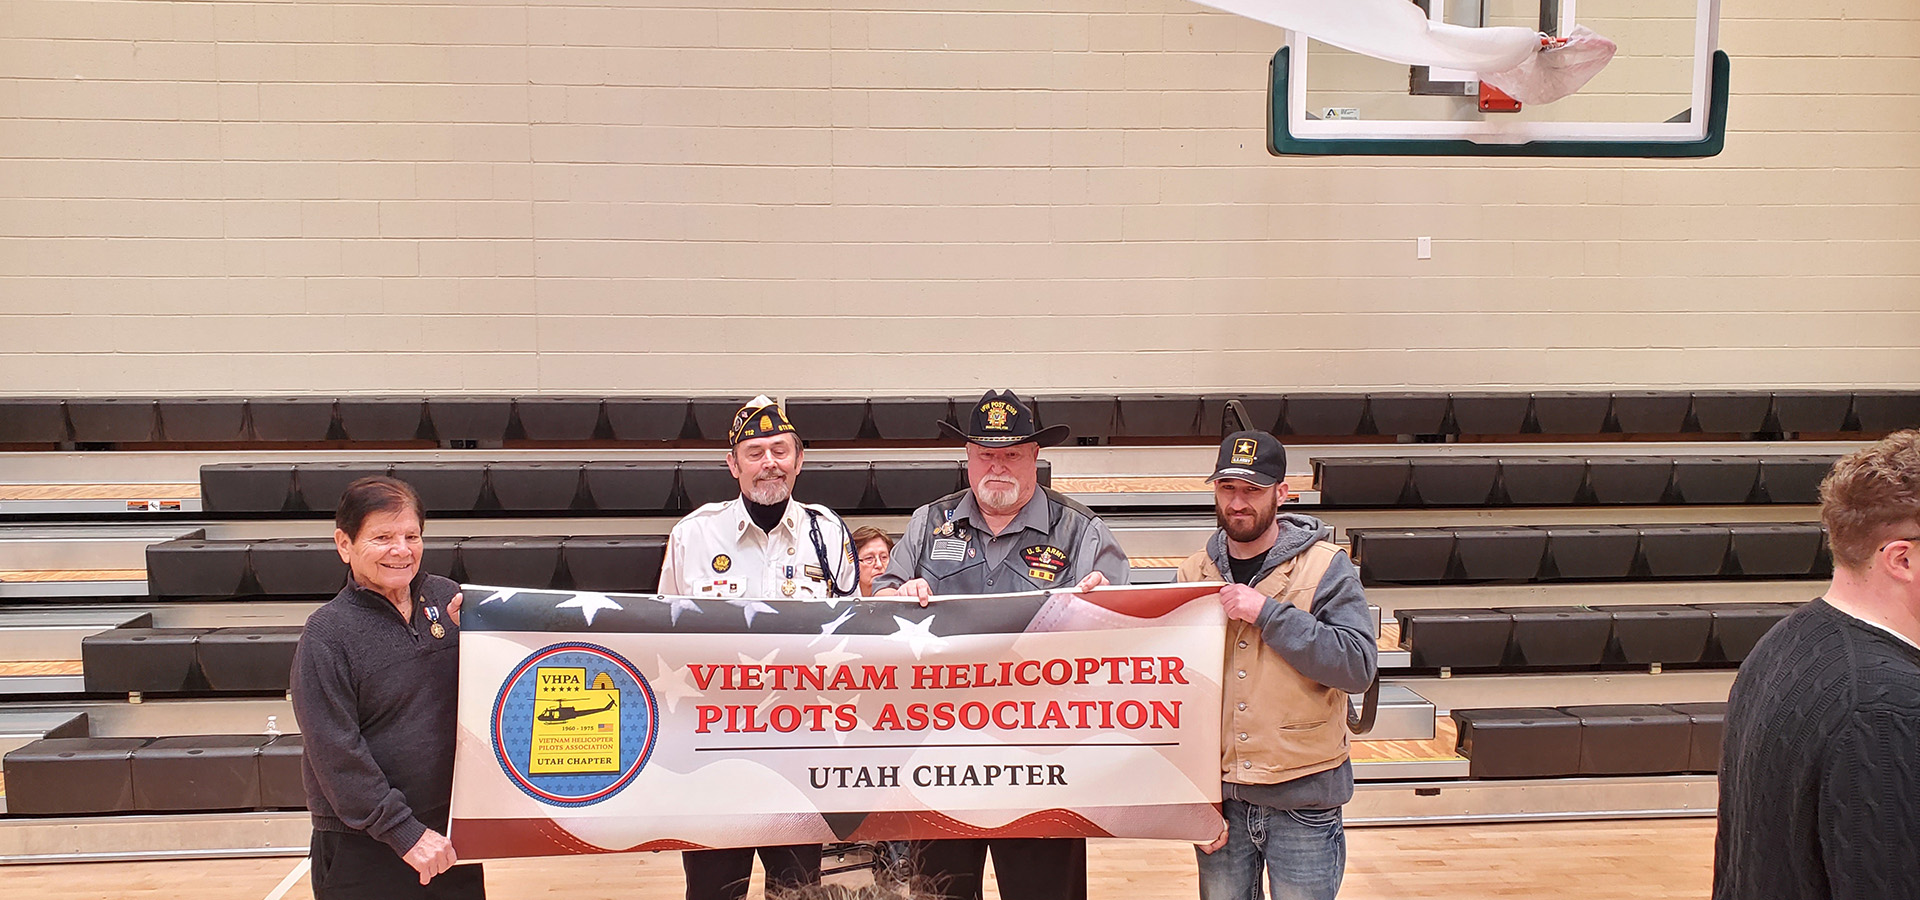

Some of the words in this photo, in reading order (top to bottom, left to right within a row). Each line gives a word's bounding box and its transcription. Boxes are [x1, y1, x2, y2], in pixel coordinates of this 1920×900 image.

[991, 401, 1006, 409] POST
[1045, 546, 1066, 560] ARMY
[541, 675, 580, 684] VHPA
[686, 663, 898, 691] VIETNAM
[911, 656, 1189, 689] HELICOPTER
[695, 704, 859, 734] PILOTS
[872, 700, 1183, 732] ASSOCIATION
[567, 757, 612, 765] CHAPTER
[808, 765, 900, 789] UTAH
[912, 763, 1068, 788] CHAPTER
